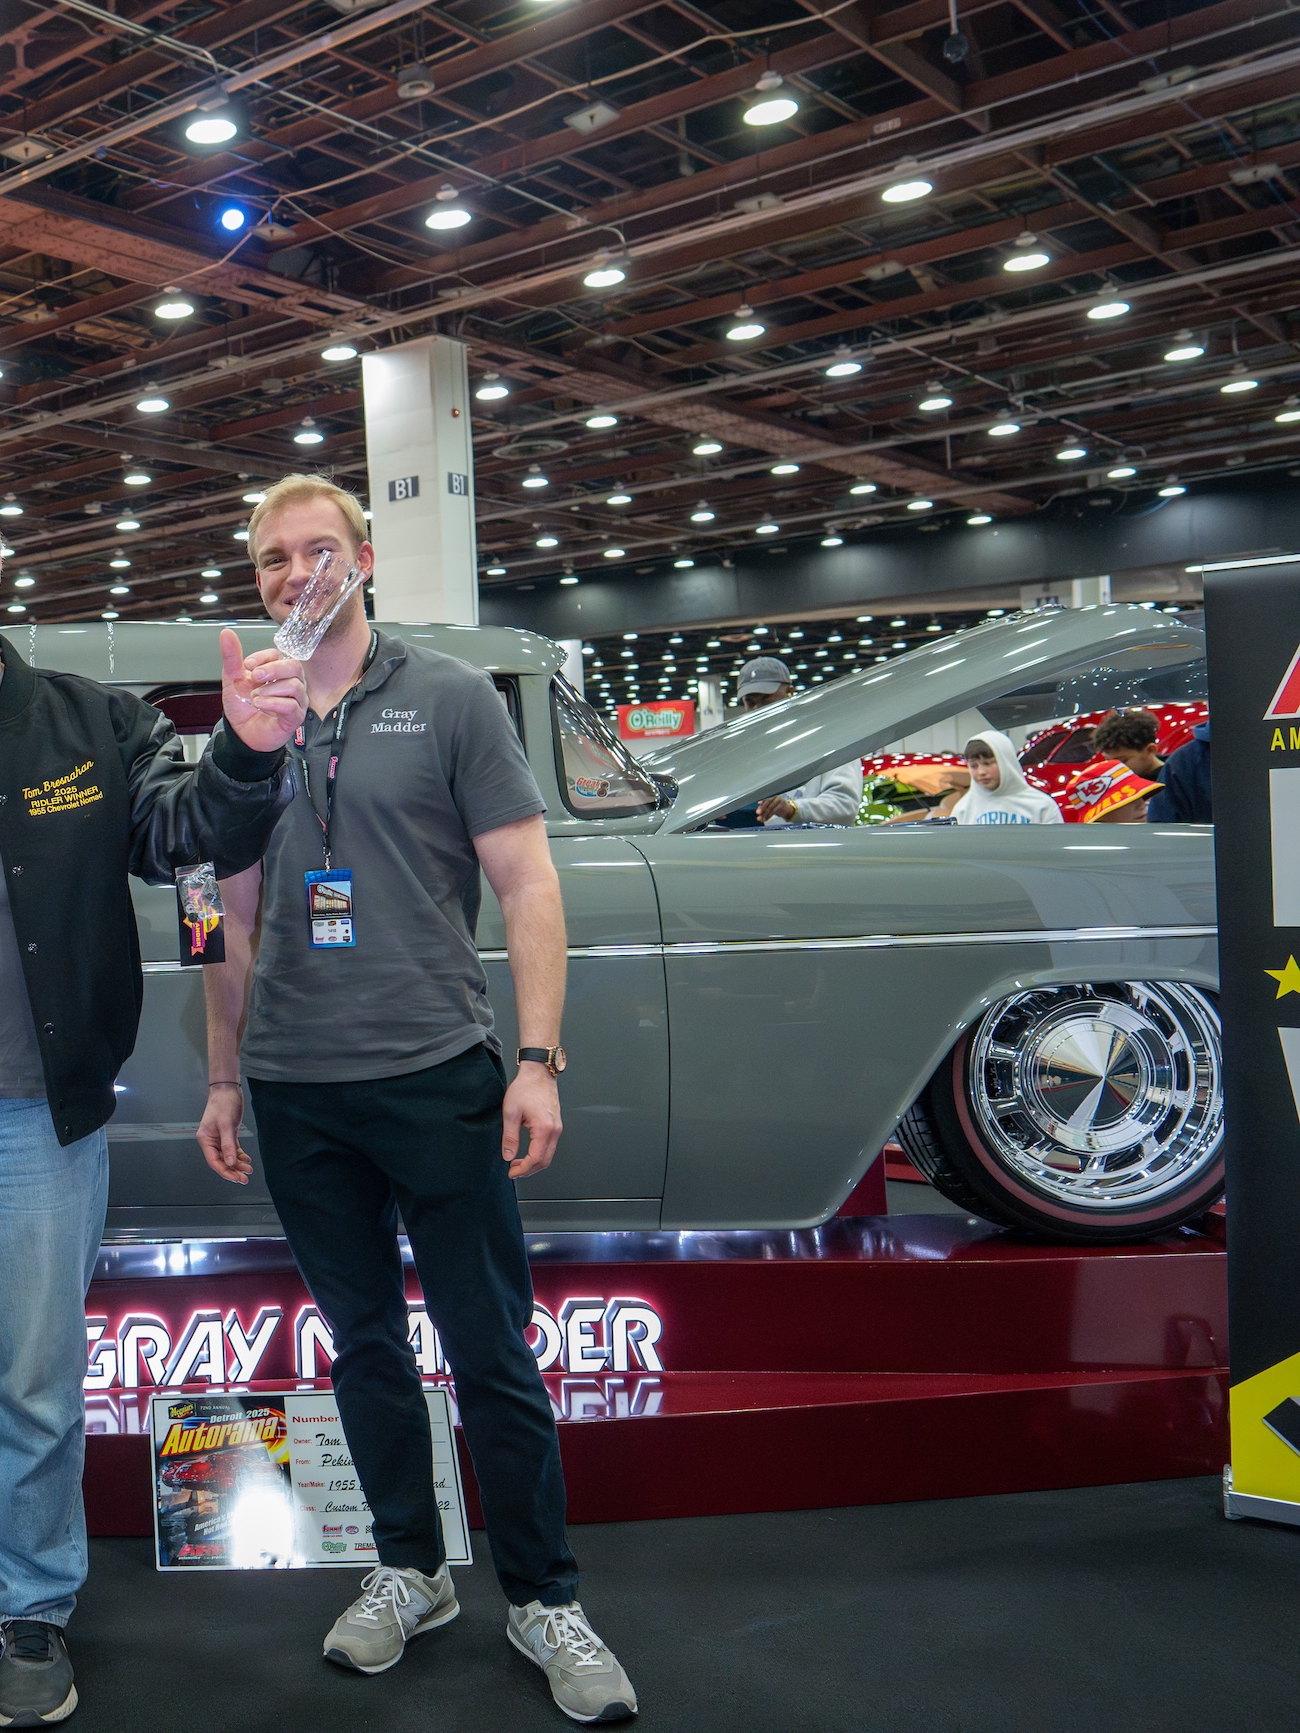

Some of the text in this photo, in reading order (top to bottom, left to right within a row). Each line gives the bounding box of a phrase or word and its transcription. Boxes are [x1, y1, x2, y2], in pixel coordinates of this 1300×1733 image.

[395, 478, 413, 500] B1
[452, 474, 465, 495] B1
[381, 708, 418, 721] Gray
[629, 709, 682, 730] O'Reilly
[370, 721, 427, 733] Madder
[1271, 726, 1300, 751] AM
[22, 760, 94, 799] Tom Bresnahan
[577, 777, 609, 797] Great 8
[31, 785, 99, 808] RIDLER WINNER
[54, 785, 77, 796] 2025
[28, 791, 104, 816] 1955 Chevrolet Nomad
[1084, 784, 1137, 823] HIEFS
[210, 1408, 270, 1424] Detroit 2025
[292, 1416, 339, 1424] Number
[160, 1416, 280, 1457] Autorama
[315, 1433, 342, 1446] Tom
[328, 1479, 356, 1491] 1955
[324, 1501, 359, 1513] Custom
